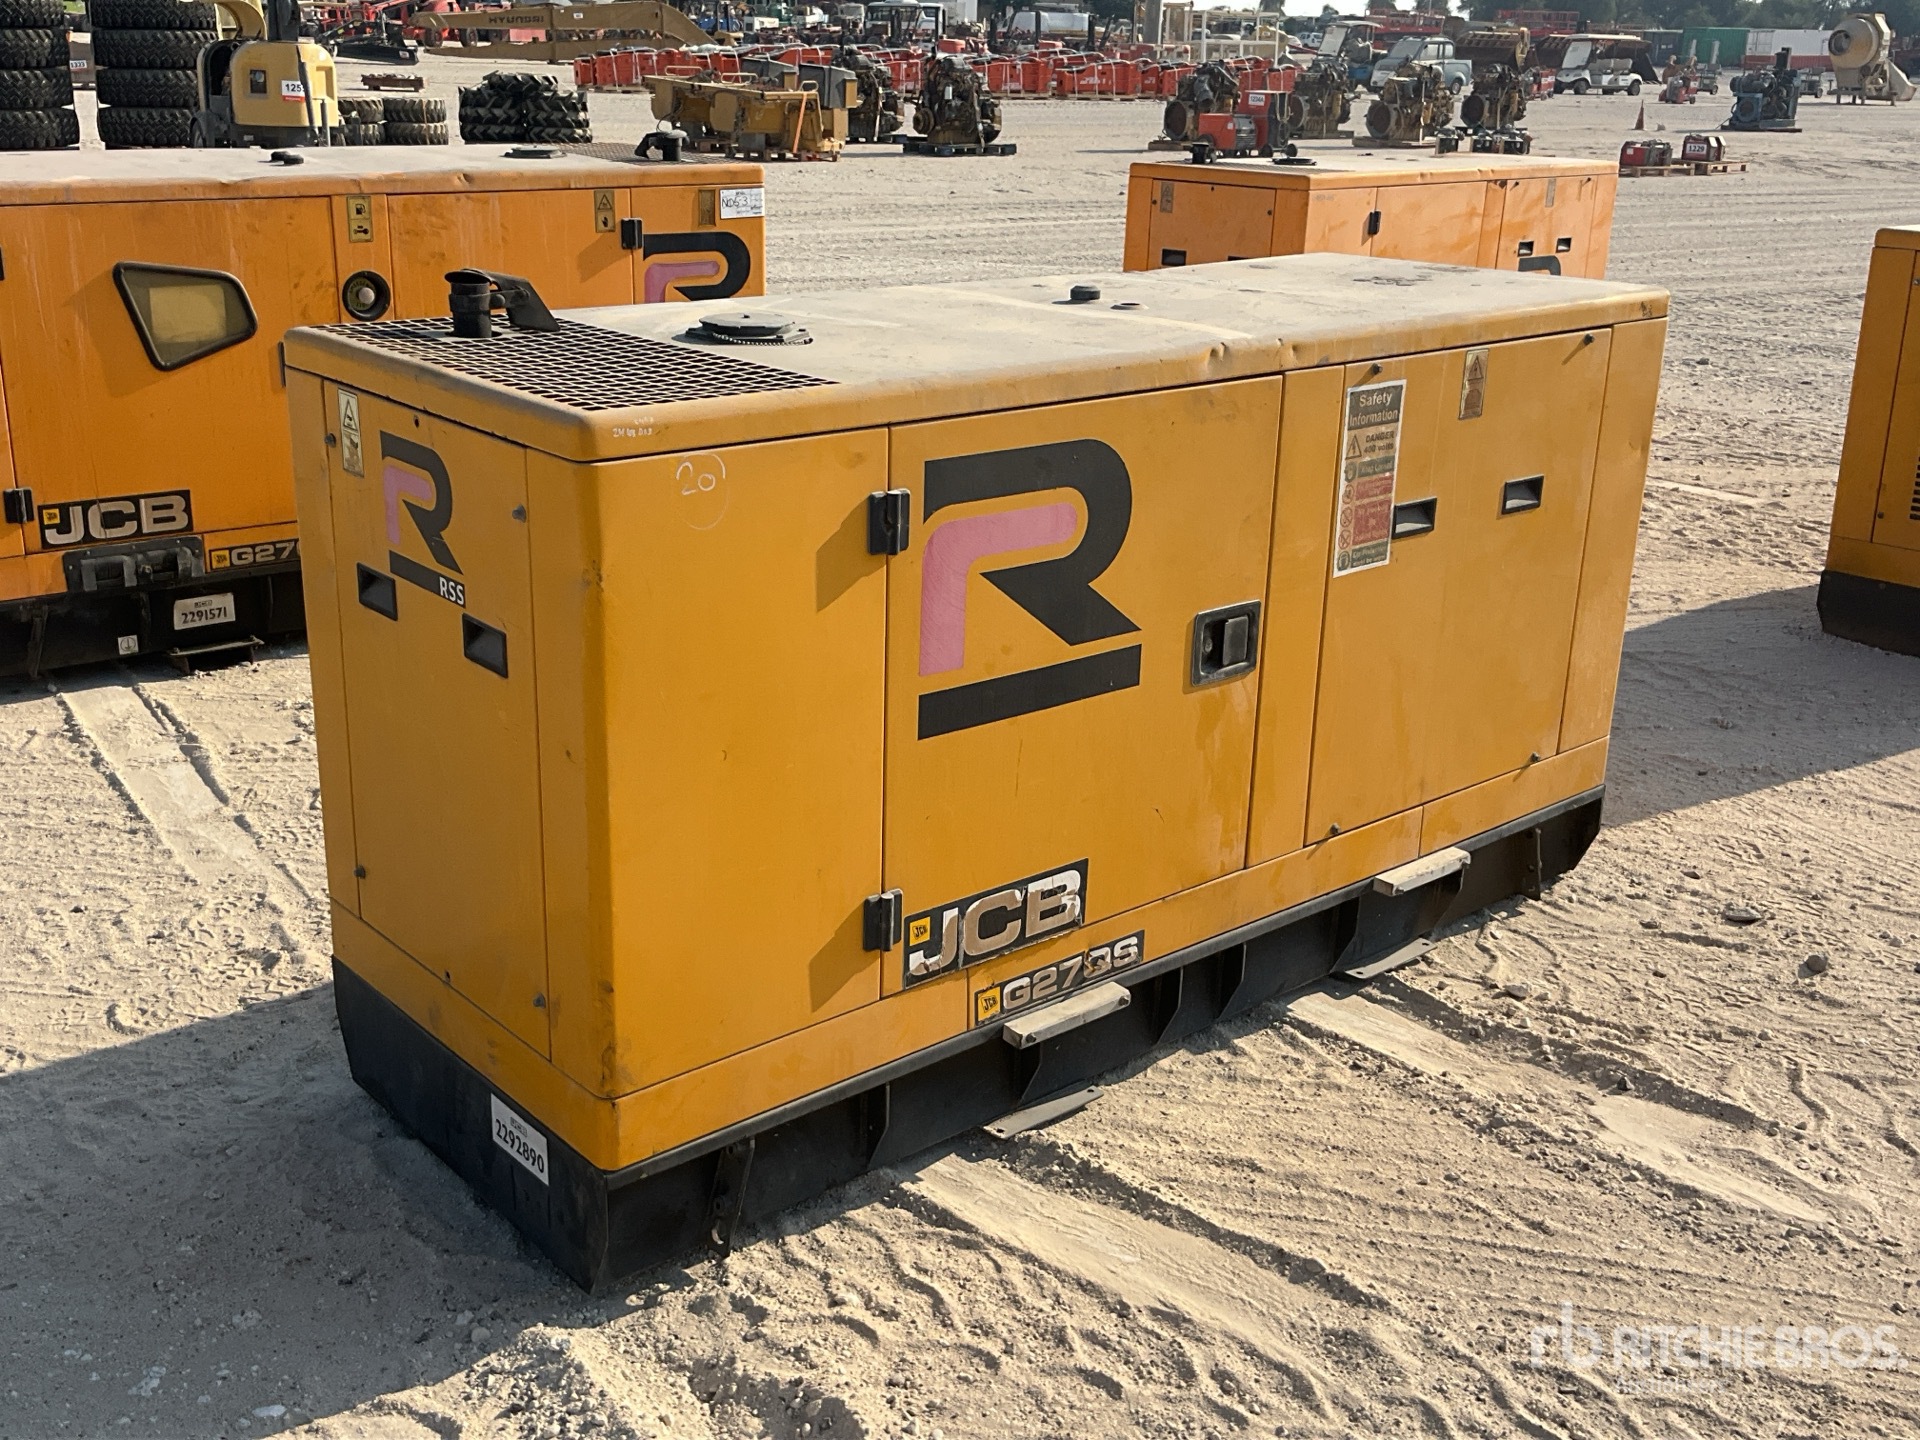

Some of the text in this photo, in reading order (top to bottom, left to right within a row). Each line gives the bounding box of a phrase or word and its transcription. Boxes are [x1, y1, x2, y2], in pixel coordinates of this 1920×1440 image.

[488, 15, 544, 24] HYUNDAI
[285, 83, 304, 93] 125
[1359, 392, 1392, 408] Safety
[1350, 409, 1399, 427] Information
[1365, 430, 1395, 443] DANGER
[676, 461, 716, 496] 20
[45, 495, 189, 545] JCB
[230, 540, 301, 565] G27
[439, 576, 465, 605] RSS
[181, 606, 227, 625] 2291571
[908, 869, 1081, 976] JCB
[981, 995, 999, 1013] JCB
[496, 1118, 545, 1173] 2292890
